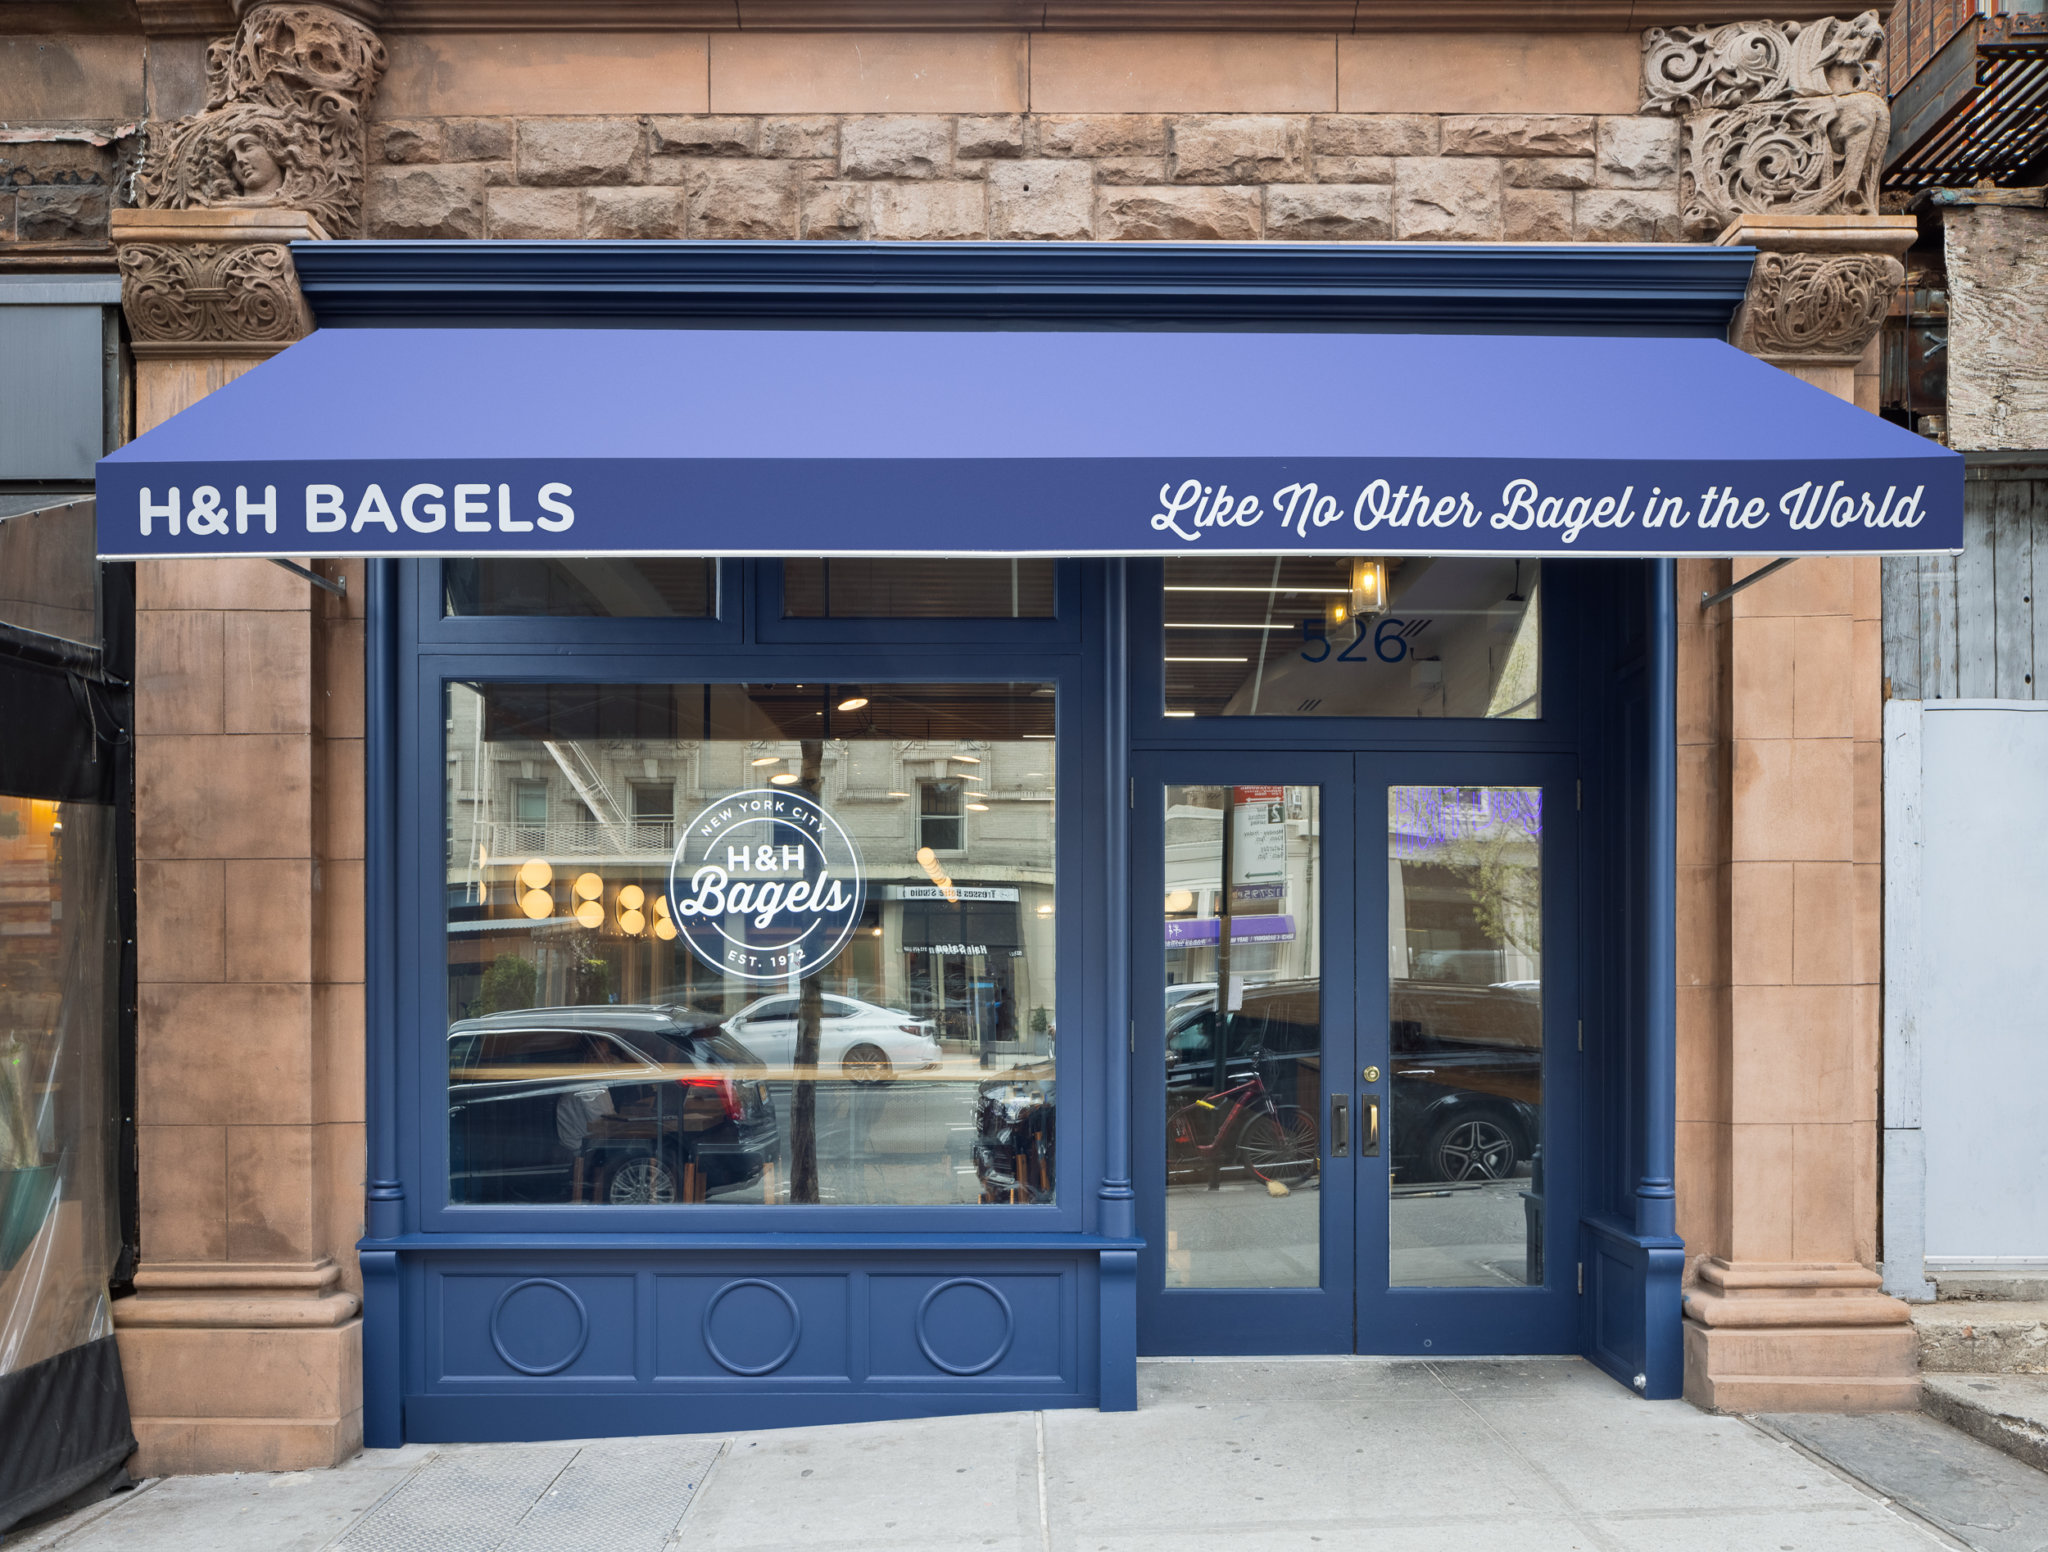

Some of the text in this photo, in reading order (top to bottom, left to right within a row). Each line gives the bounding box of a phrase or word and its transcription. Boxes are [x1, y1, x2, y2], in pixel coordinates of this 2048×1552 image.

[139, 482, 575, 536] H&H BAGELS
[1150, 478, 1926, 544] Like No Other Bagel in the World
[1300, 618, 1408, 663] 526
[701, 800, 827, 837] NEW YORK CITY
[727, 844, 805, 872] H&H
[679, 865, 852, 930] Bagels
[728, 948, 806, 968] EST. 1972
